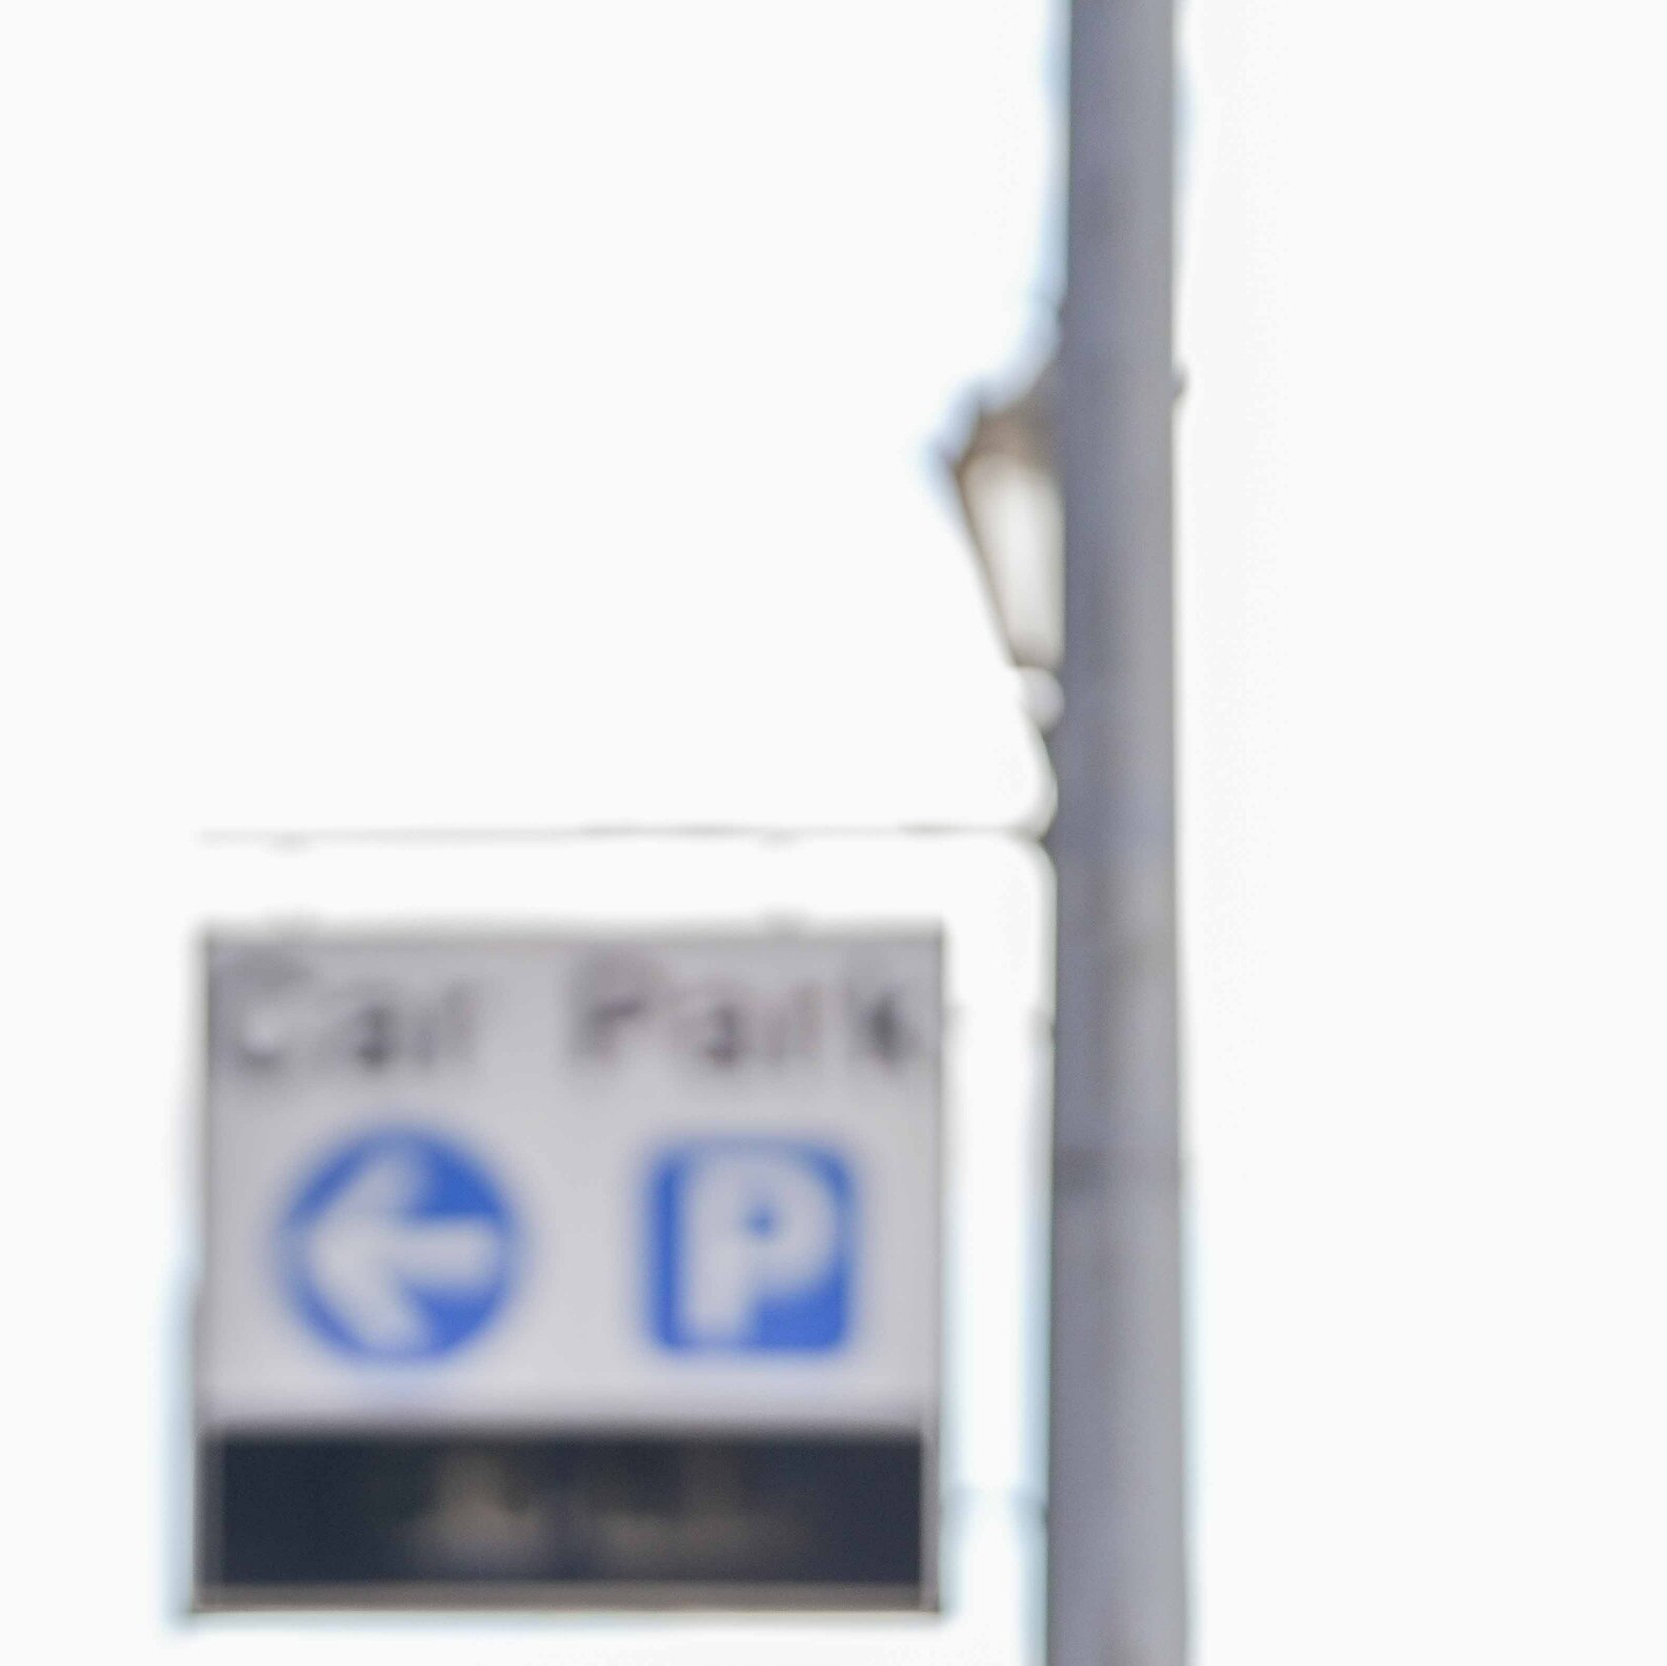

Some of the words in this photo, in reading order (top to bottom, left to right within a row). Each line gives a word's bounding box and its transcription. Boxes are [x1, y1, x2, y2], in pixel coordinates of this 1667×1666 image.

[220, 948, 482, 1076] Car
[569, 950, 925, 1074] Park
[679, 1148, 841, 1346] P
